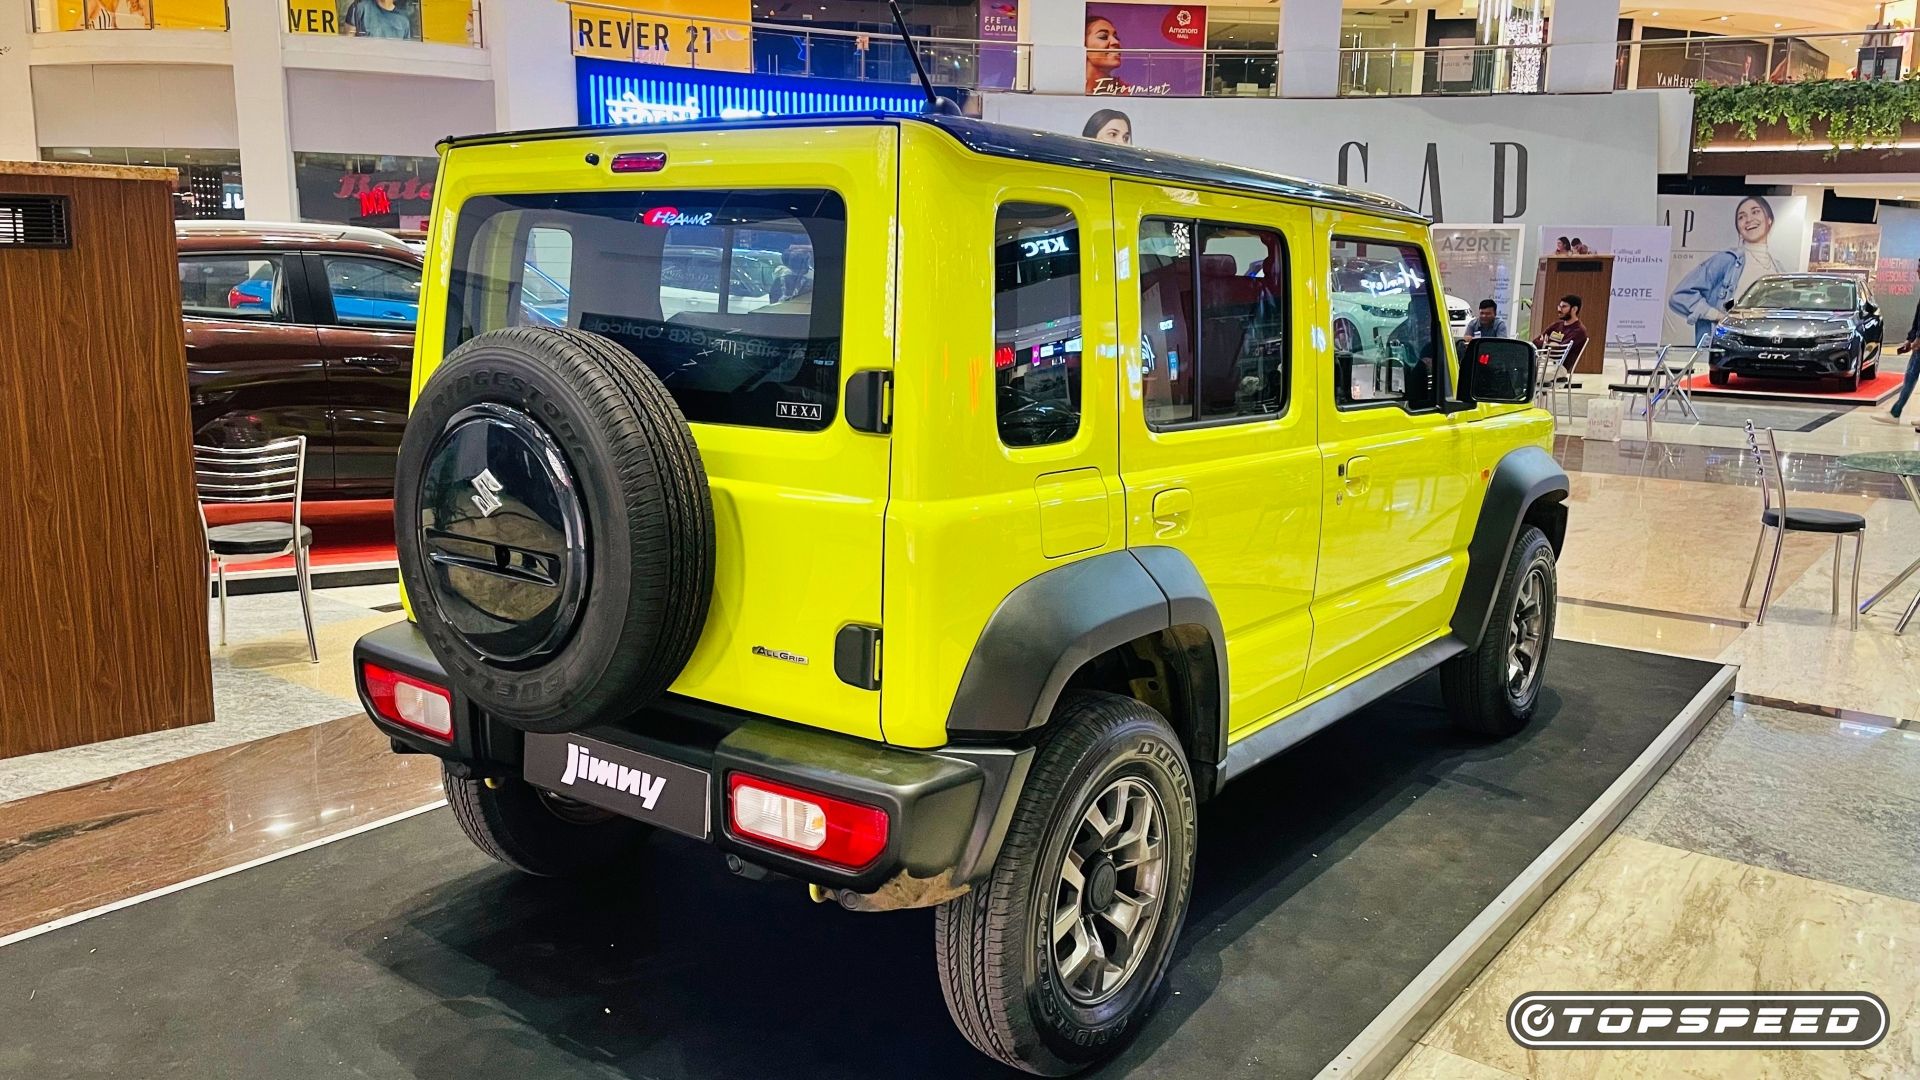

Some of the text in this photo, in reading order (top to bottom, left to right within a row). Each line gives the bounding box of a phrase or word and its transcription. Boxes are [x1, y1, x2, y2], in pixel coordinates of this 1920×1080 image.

[578, 19, 711, 54] REVER 21
[1168, 26, 1198, 35] Amanora
[1092, 78, 1171, 95] Enjoyment
[1441, 237, 1512, 252] AZORTE
[1610, 288, 1652, 298] AZORTE
[1757, 351, 1791, 360] CITY
[780, 404, 819, 417] NEXA
[560, 742, 667, 810] Jimny
